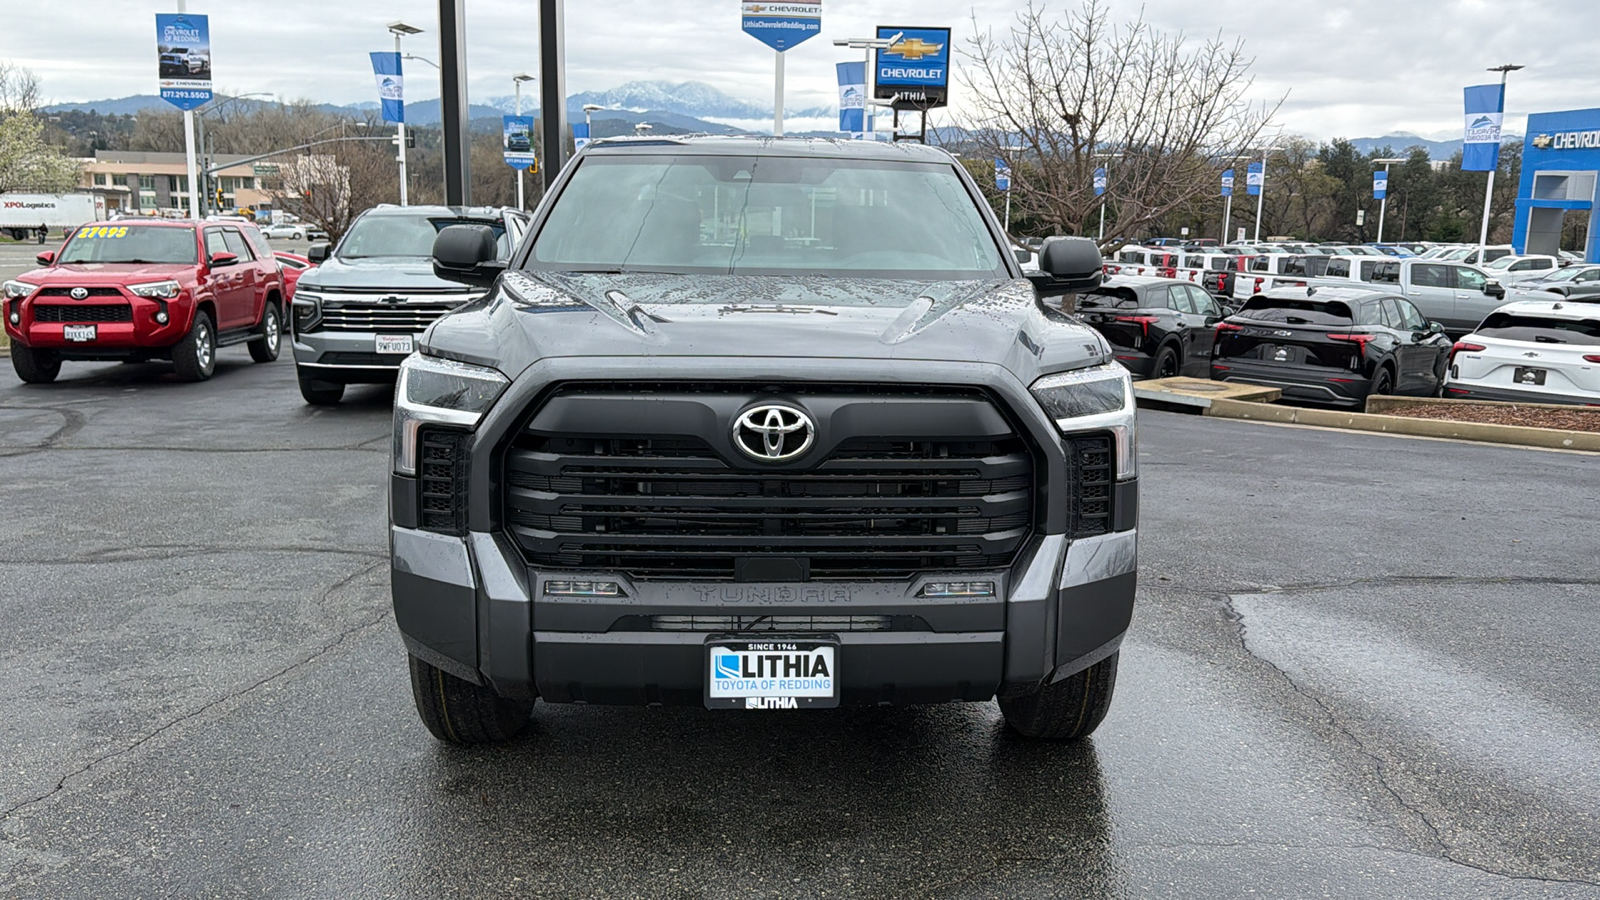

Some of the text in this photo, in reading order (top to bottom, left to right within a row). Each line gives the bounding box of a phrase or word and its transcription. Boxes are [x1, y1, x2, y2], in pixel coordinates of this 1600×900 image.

[743, 21, 819, 31] LithiaChevroletRedding.com
[881, 68, 943, 79] CHEVROLET
[162, 90, 210, 99] 877.293.5503
[78, 226, 129, 239] 27495
[378, 342, 411, 351] 9WFU073
[692, 586, 853, 603] TUNDRA
[747, 643, 797, 651] SINCE 1946
[742, 654, 830, 678] LITHIA
[714, 679, 831, 690] TOYOTA OF REDDING
[758, 697, 798, 709] LITHIA
